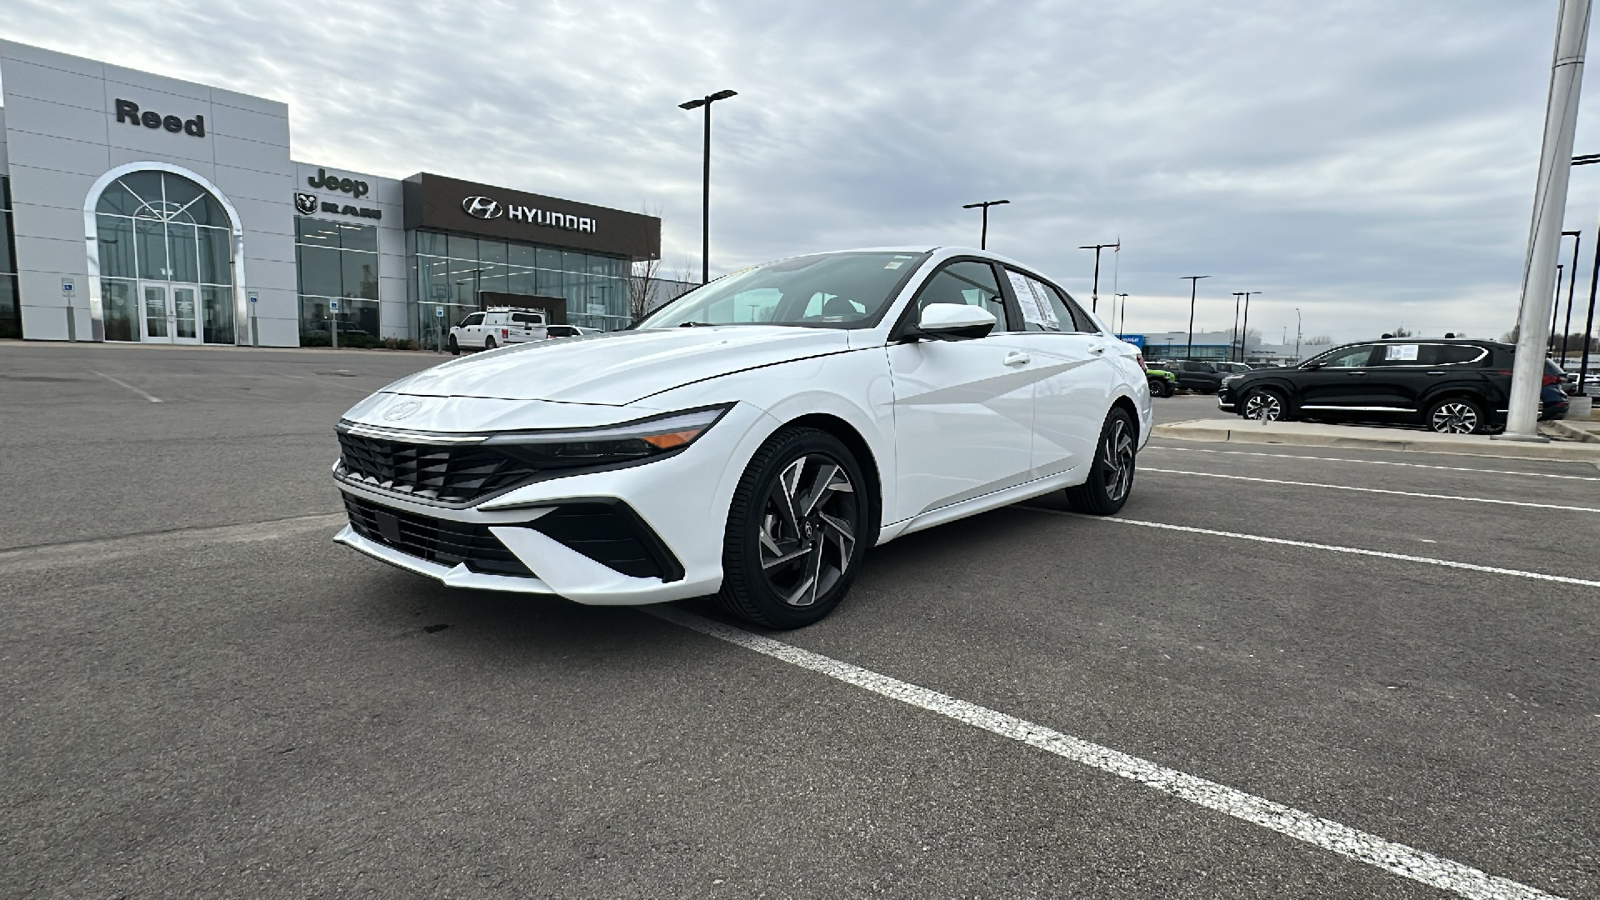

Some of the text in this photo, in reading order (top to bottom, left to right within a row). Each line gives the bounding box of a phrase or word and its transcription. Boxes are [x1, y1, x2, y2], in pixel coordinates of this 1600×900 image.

[115, 98, 205, 138] Reed
[308, 168, 369, 199] Jeep
[321, 201, 382, 220] RAM
[508, 204, 596, 234] HYUNDAI
